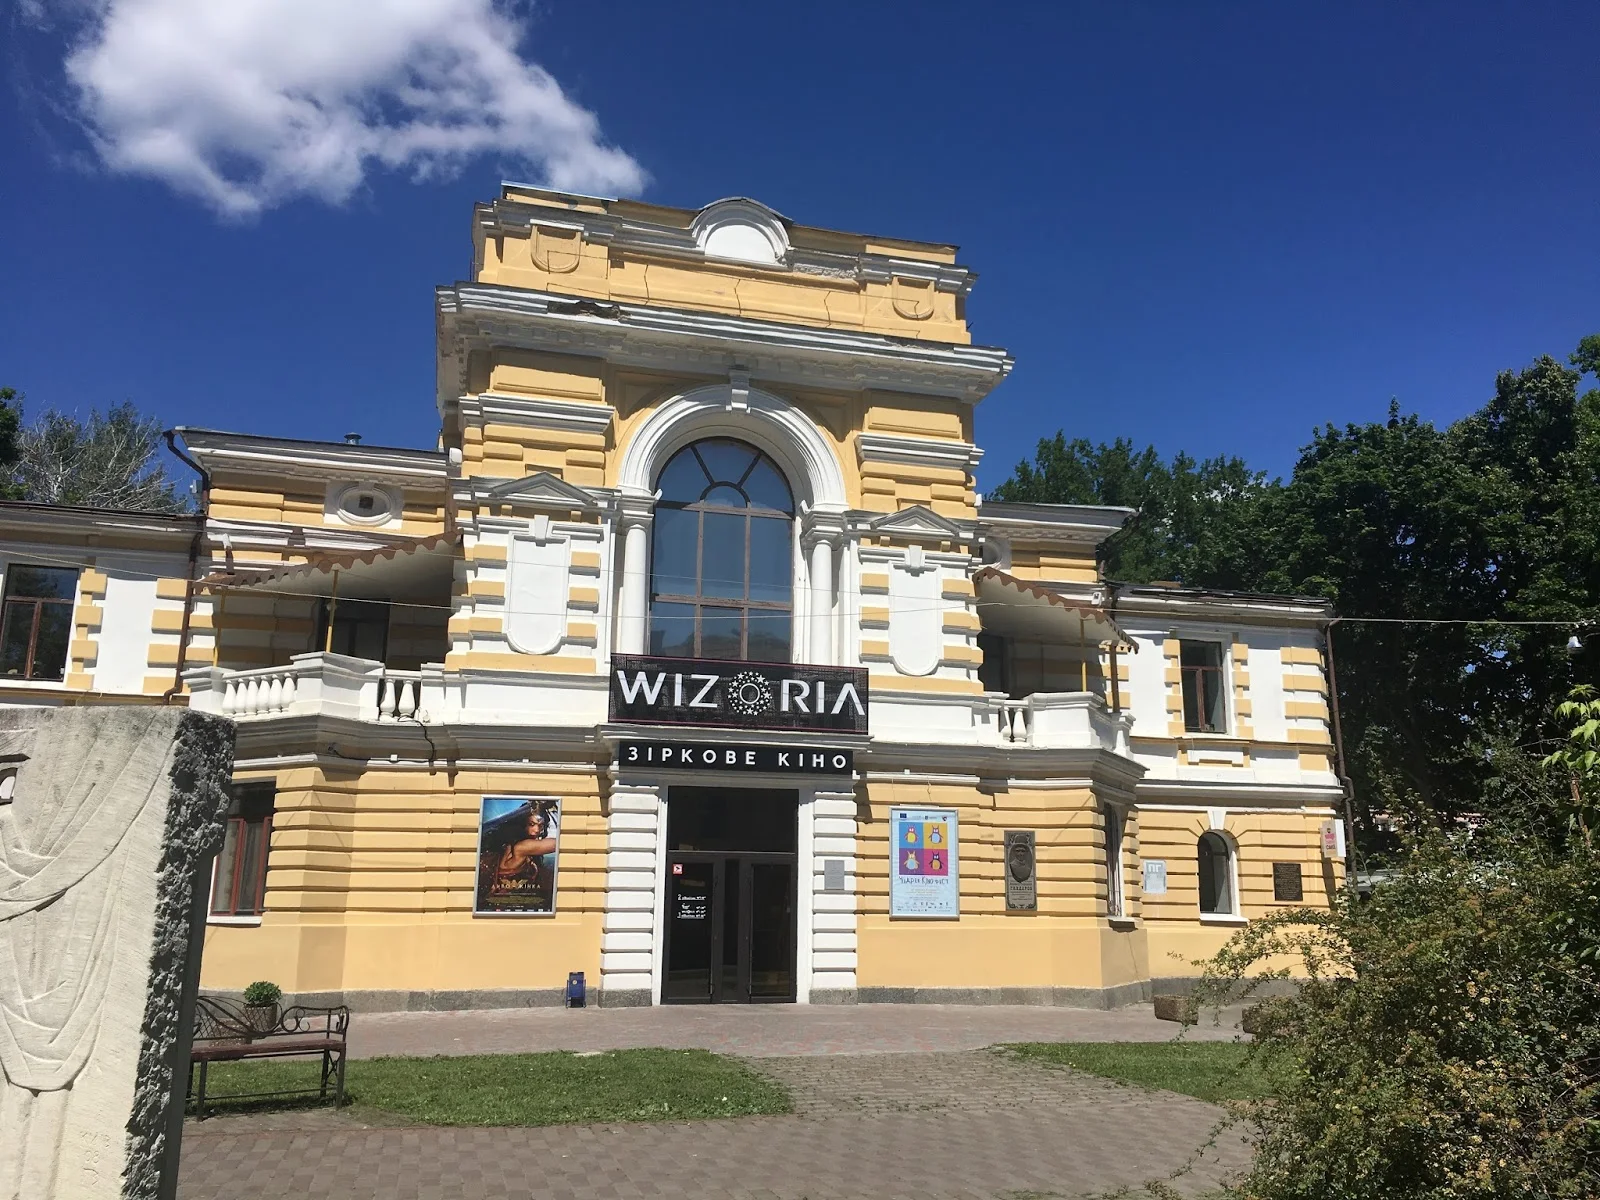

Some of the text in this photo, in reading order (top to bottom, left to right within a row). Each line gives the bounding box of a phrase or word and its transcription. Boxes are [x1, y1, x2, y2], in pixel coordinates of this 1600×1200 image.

[617, 670, 866, 716] WIZORIA
[628, 746, 847, 769] ЗІРКОВЕ КІНО
